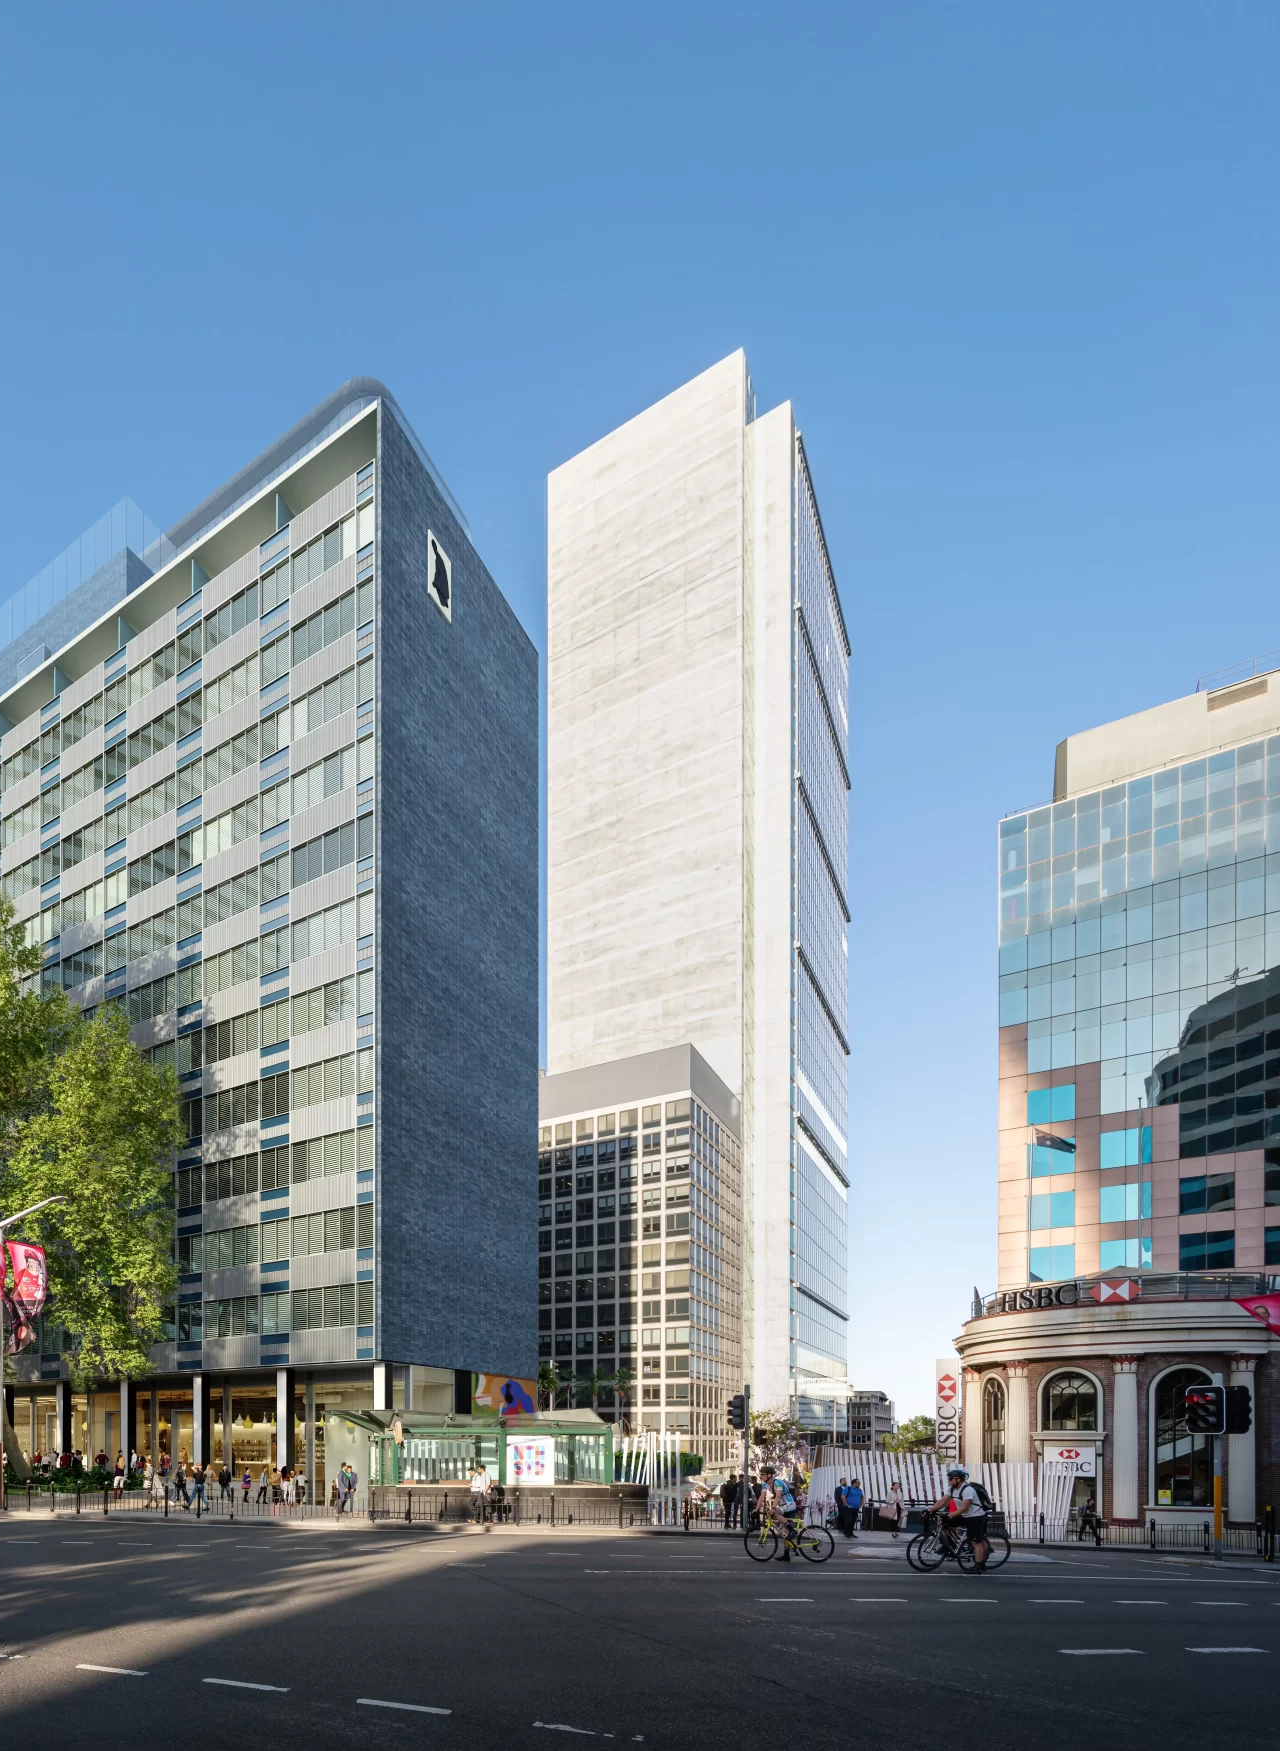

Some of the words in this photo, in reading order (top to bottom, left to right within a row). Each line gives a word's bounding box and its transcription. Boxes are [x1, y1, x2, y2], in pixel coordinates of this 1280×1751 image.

[1001, 1284, 1078, 1312] HSBC
[513, 1445, 545, 1460] NTH
[513, 1461, 545, 1476] SYD
